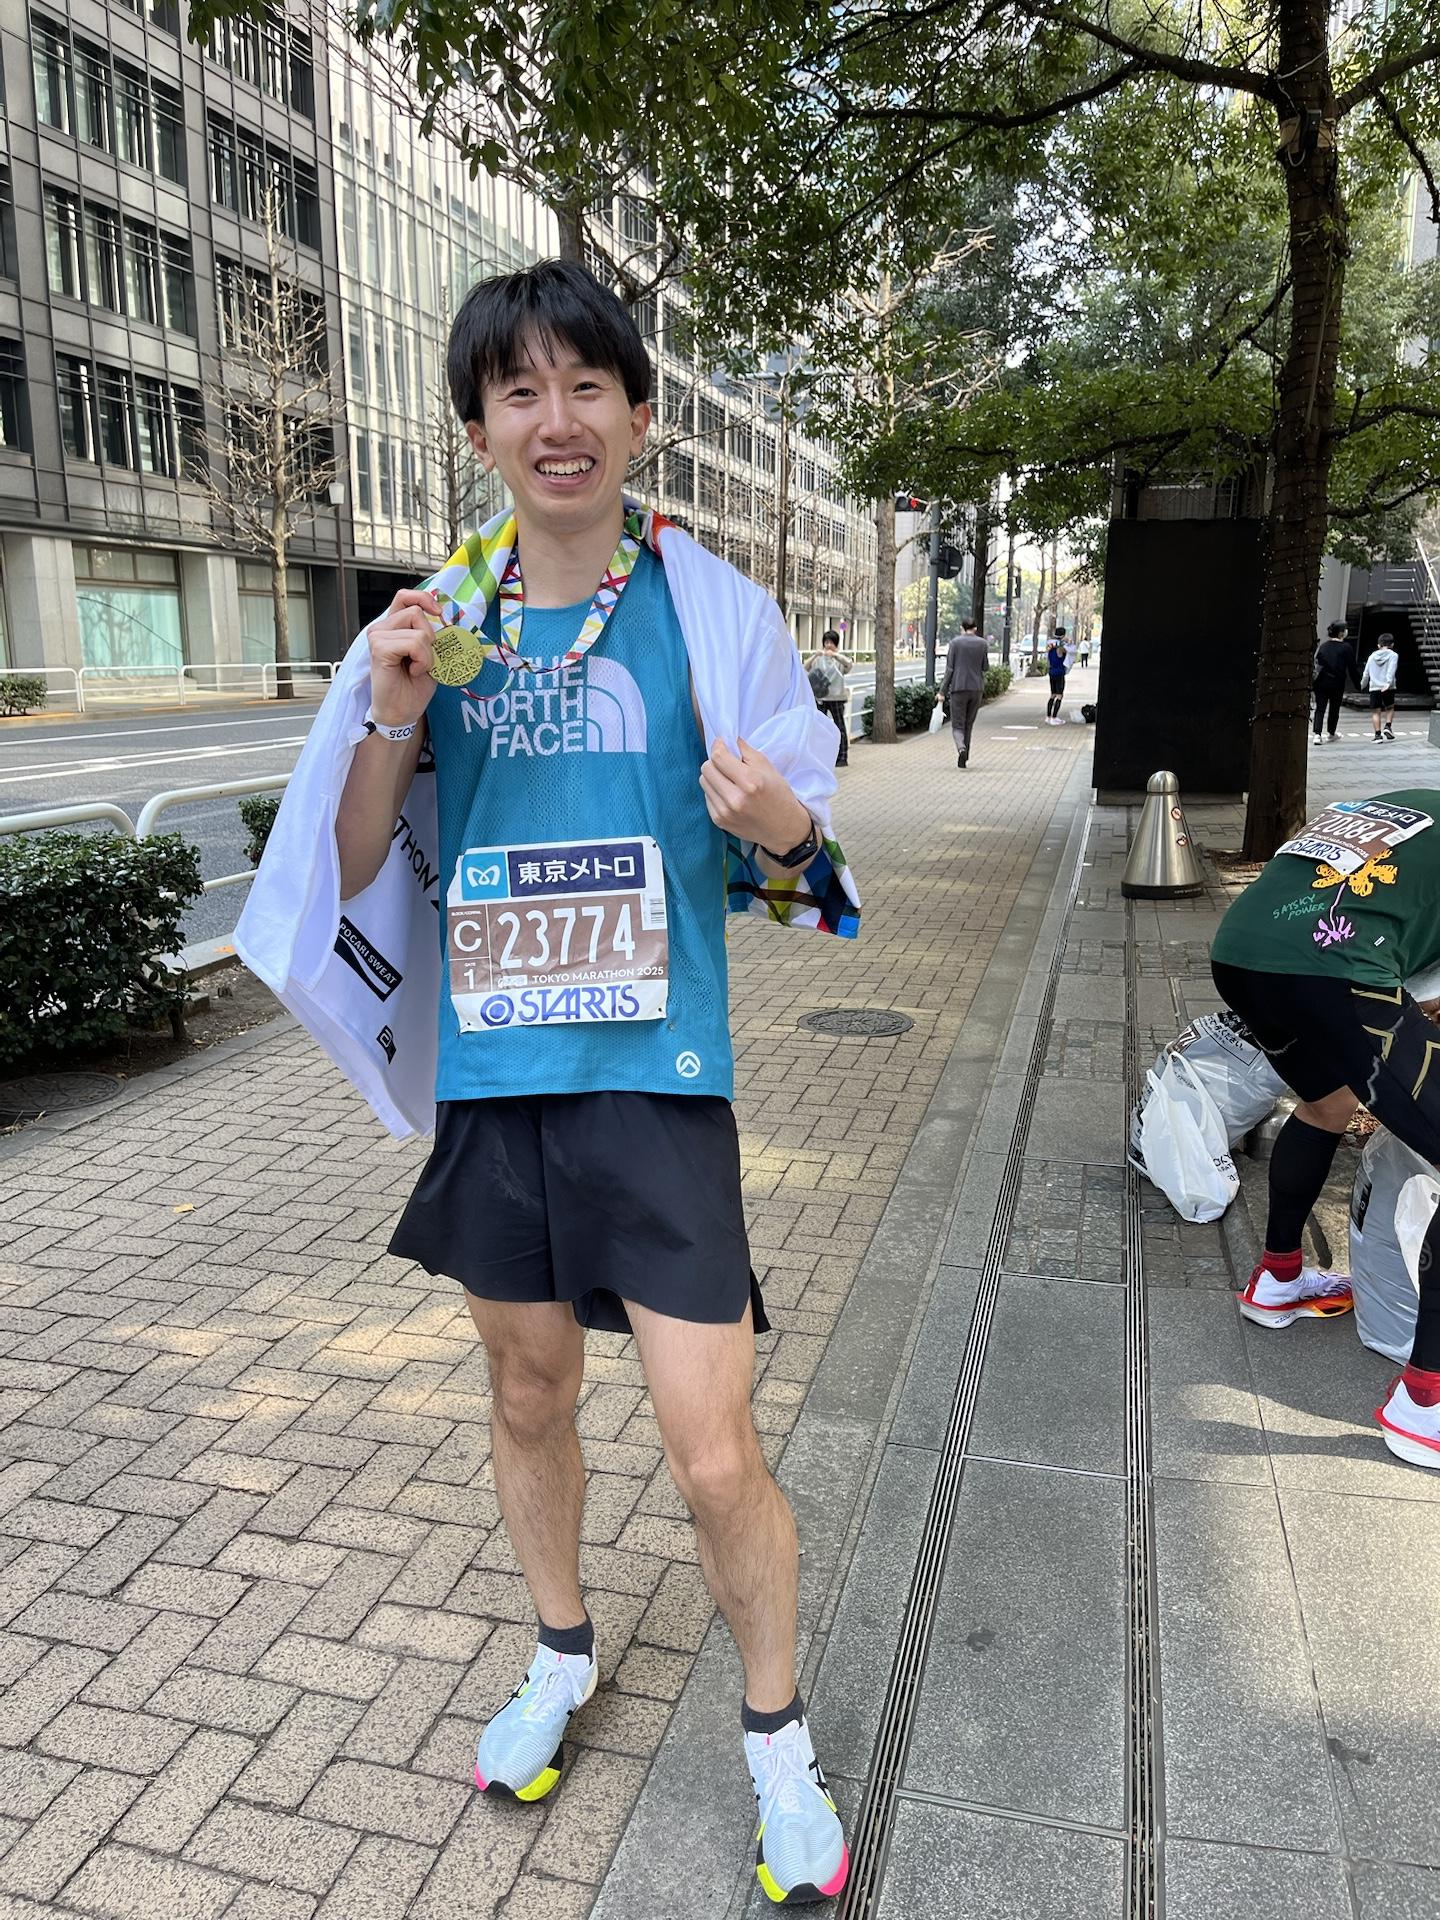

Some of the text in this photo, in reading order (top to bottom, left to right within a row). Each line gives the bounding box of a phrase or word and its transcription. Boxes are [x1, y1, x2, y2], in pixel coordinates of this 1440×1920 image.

[438, 643, 464, 662] 2025
[517, 655, 584, 689] THE
[460, 687, 584, 733] NORTH
[490, 719, 584, 759] FACE
[1310, 814, 1390, 845] 20884
[517, 855, 636, 885] 東京メトロ
[1287, 902, 1325, 921] POWER
[453, 919, 482, 952] C
[497, 903, 636, 970] 23774
[339, 922, 397, 984] POCARI SWEAT
[463, 968, 475, 990] 1
[532, 973, 570, 984] TOKYO
[572, 969, 635, 982] MARATHON
[636, 966, 665, 977] 2025
[517, 983, 640, 1023] STARTS
